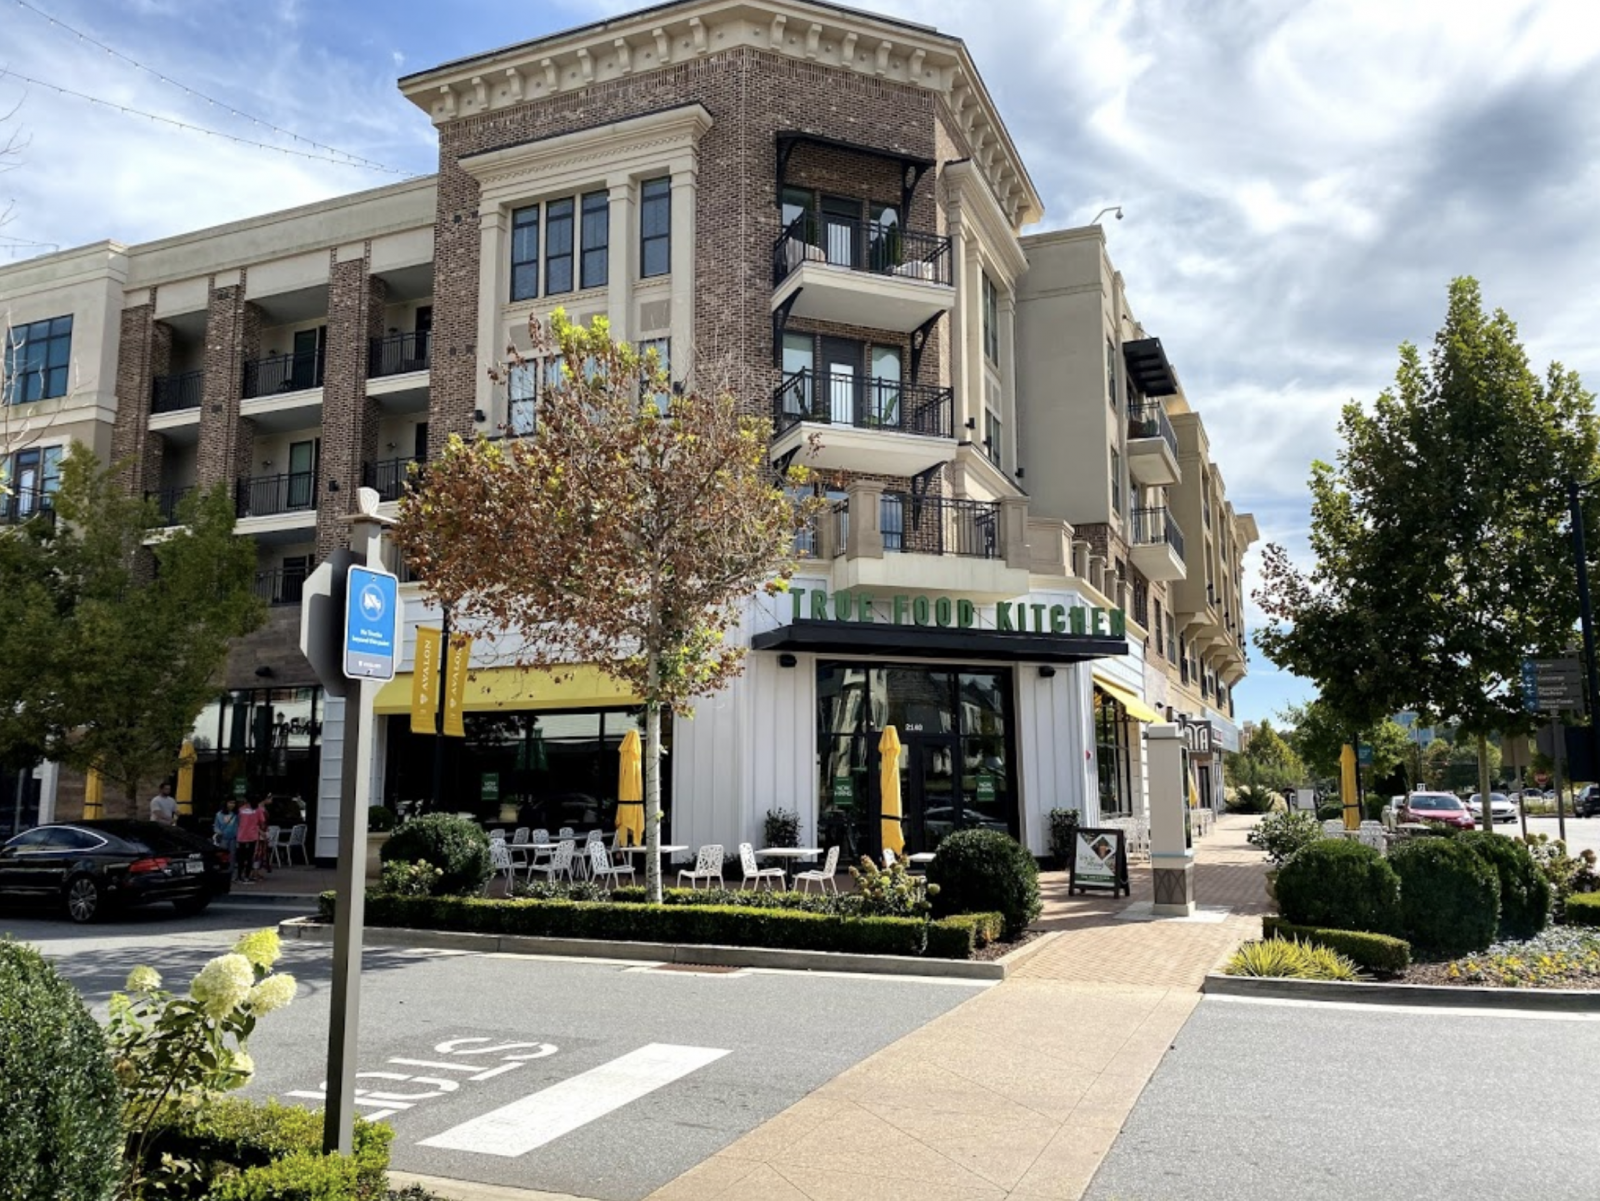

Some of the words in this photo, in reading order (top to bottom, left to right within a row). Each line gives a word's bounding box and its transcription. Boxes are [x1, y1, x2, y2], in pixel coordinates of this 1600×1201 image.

[789, 587, 875, 623] TRUE
[893, 594, 974, 629] FOOD
[996, 600, 1126, 636] KITCHEN
[422, 639, 433, 691] AVALON
